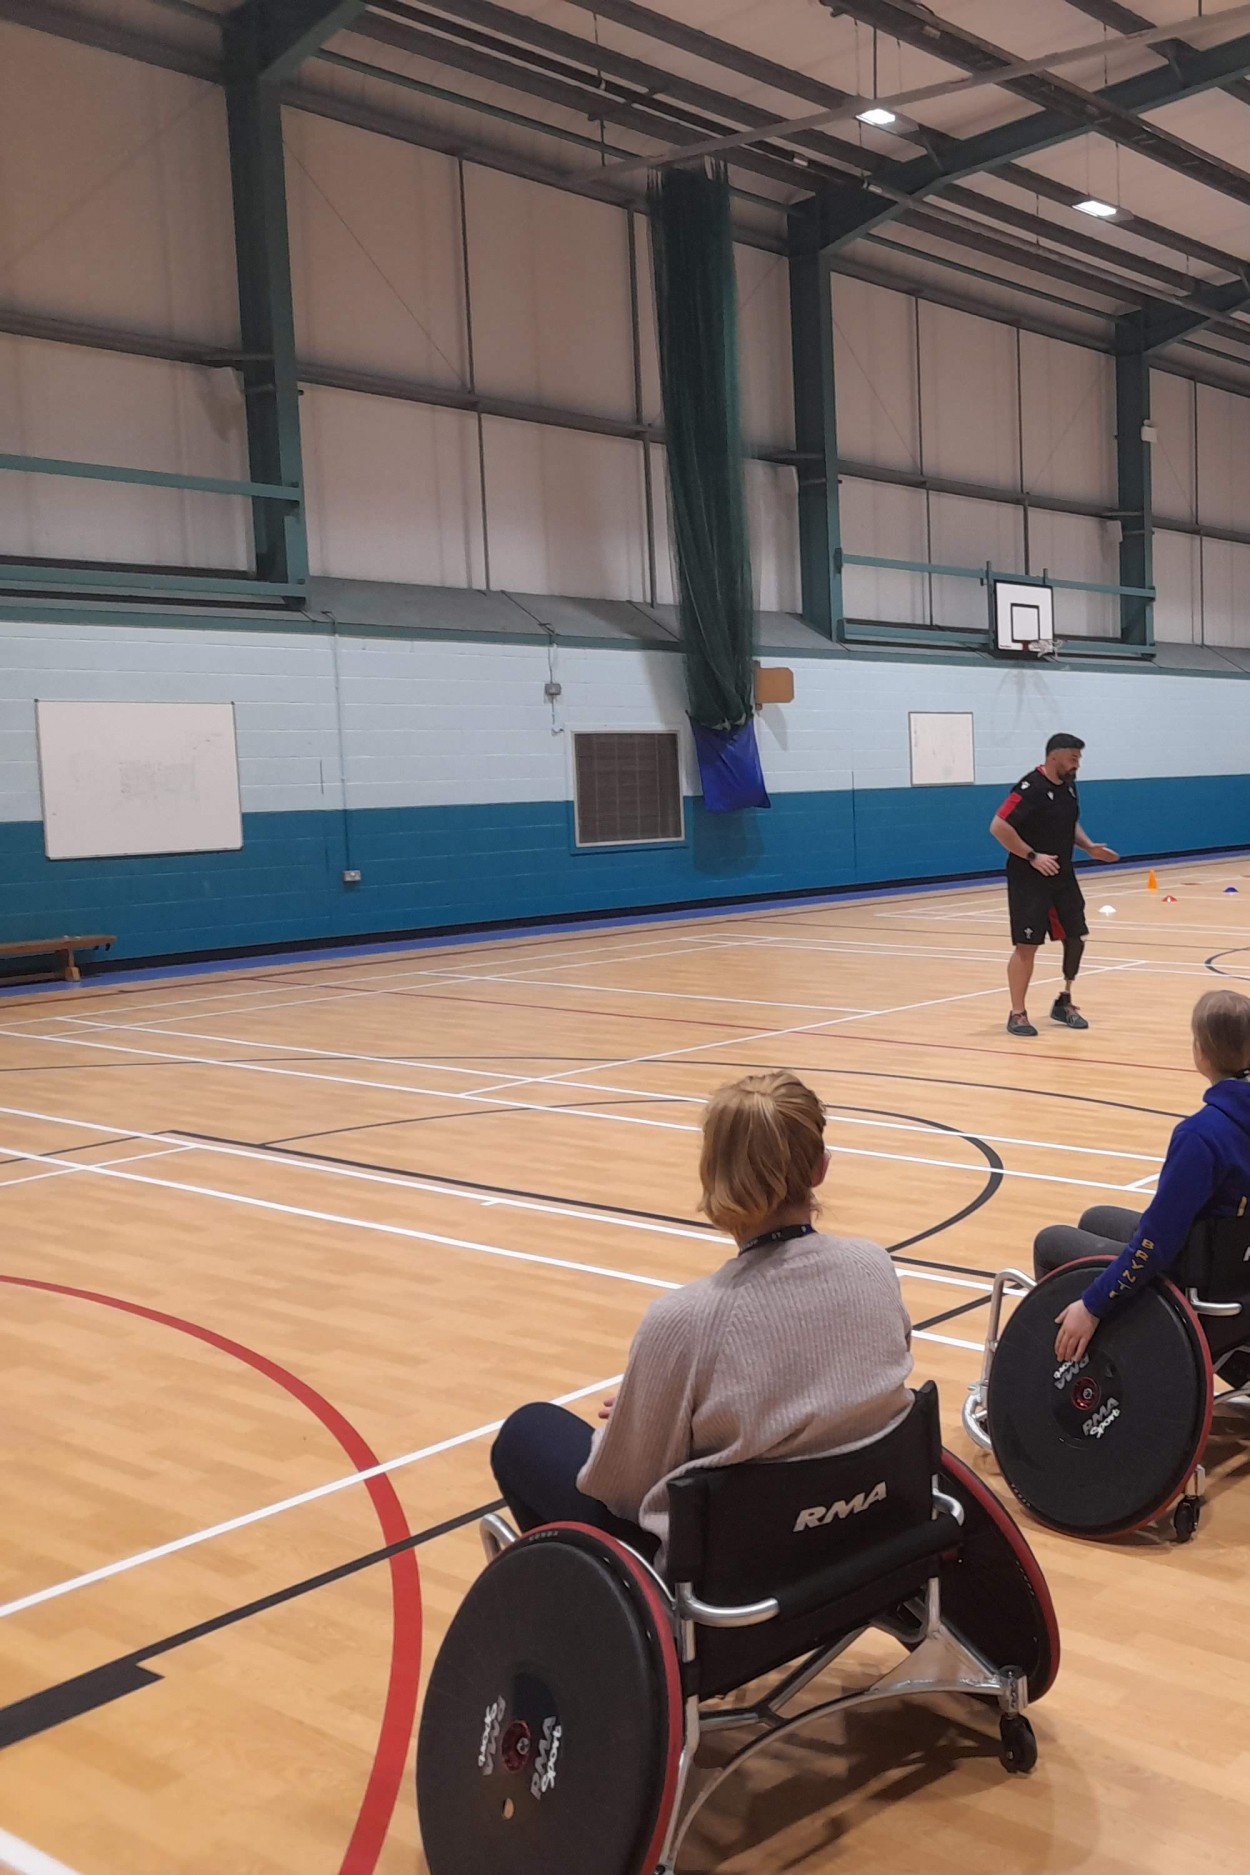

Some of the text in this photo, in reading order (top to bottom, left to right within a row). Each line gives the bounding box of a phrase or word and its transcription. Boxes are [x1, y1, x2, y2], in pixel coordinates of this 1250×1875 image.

[1082, 1397, 1120, 1436] RMA
[792, 1480, 888, 1533] RMA
[530, 1715, 557, 1800] RMA
